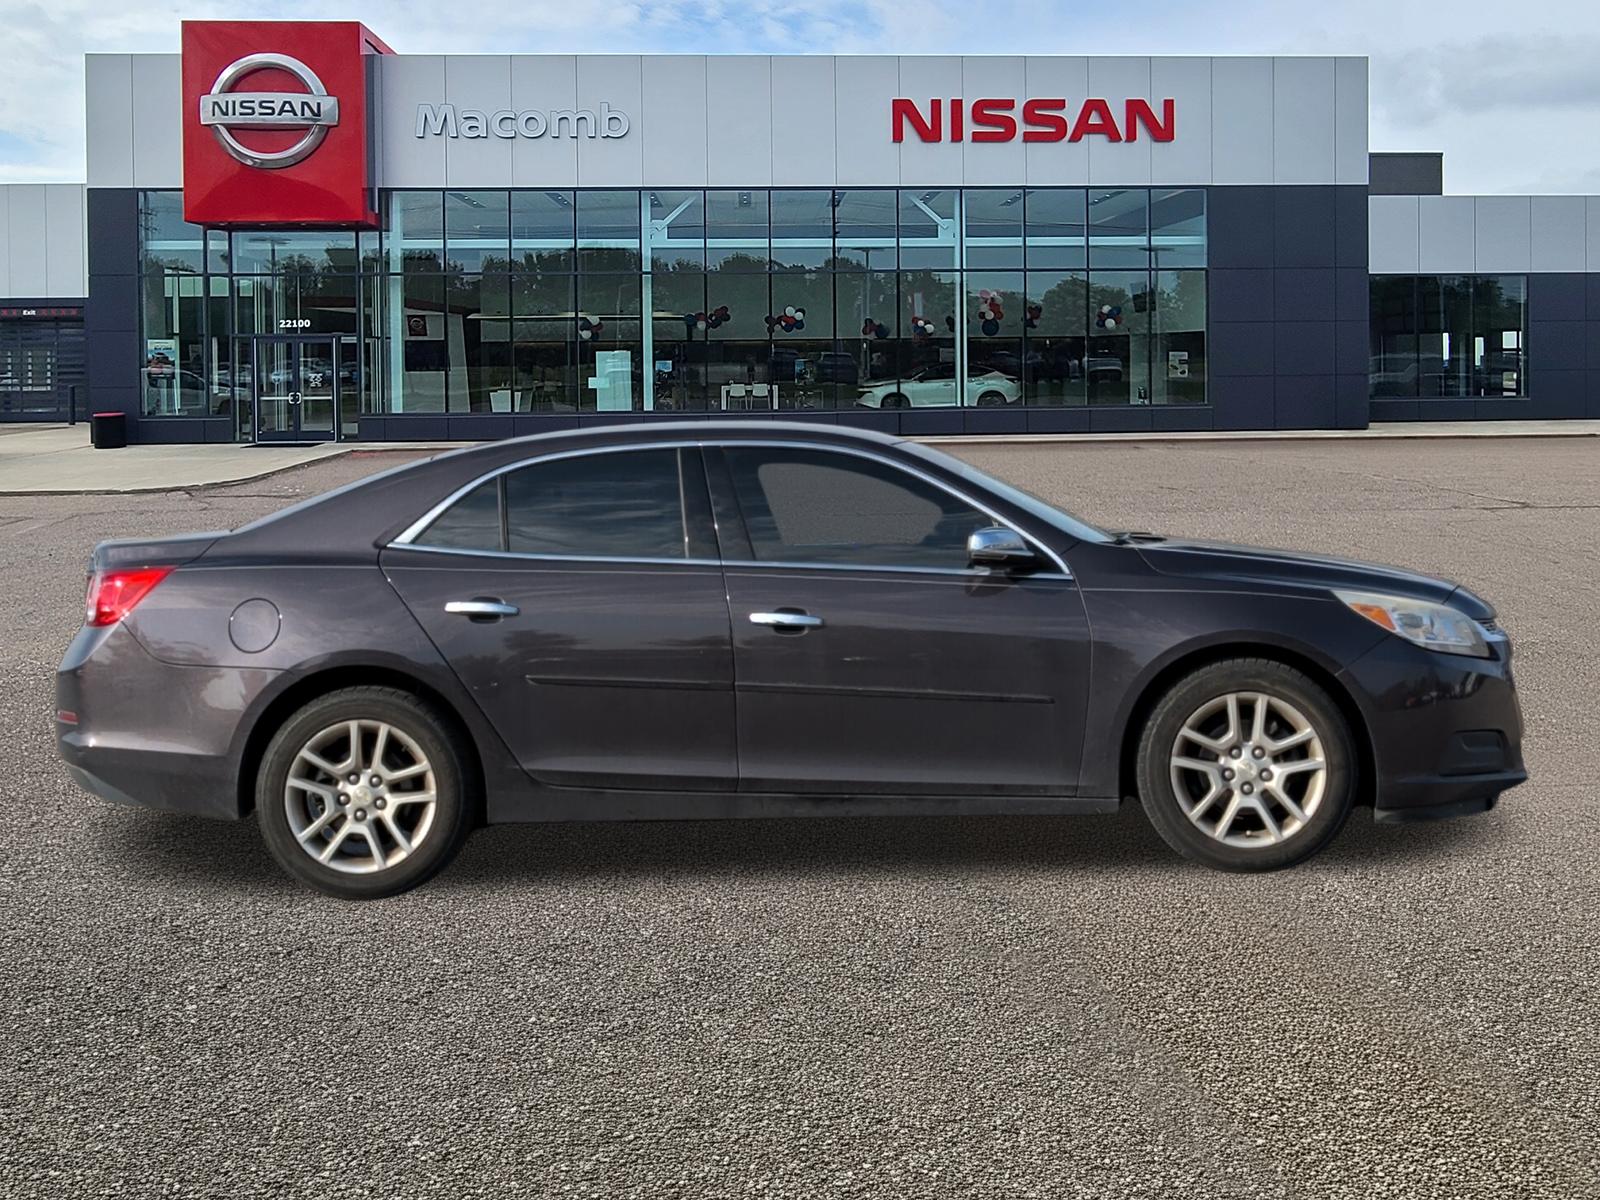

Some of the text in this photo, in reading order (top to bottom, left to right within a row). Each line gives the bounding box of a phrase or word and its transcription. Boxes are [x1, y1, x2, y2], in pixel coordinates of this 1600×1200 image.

[211, 100, 322, 117] NISSAN
[415, 102, 630, 139] Macomb
[892, 98, 1175, 143] NISSAN
[279, 319, 311, 328] 22100
